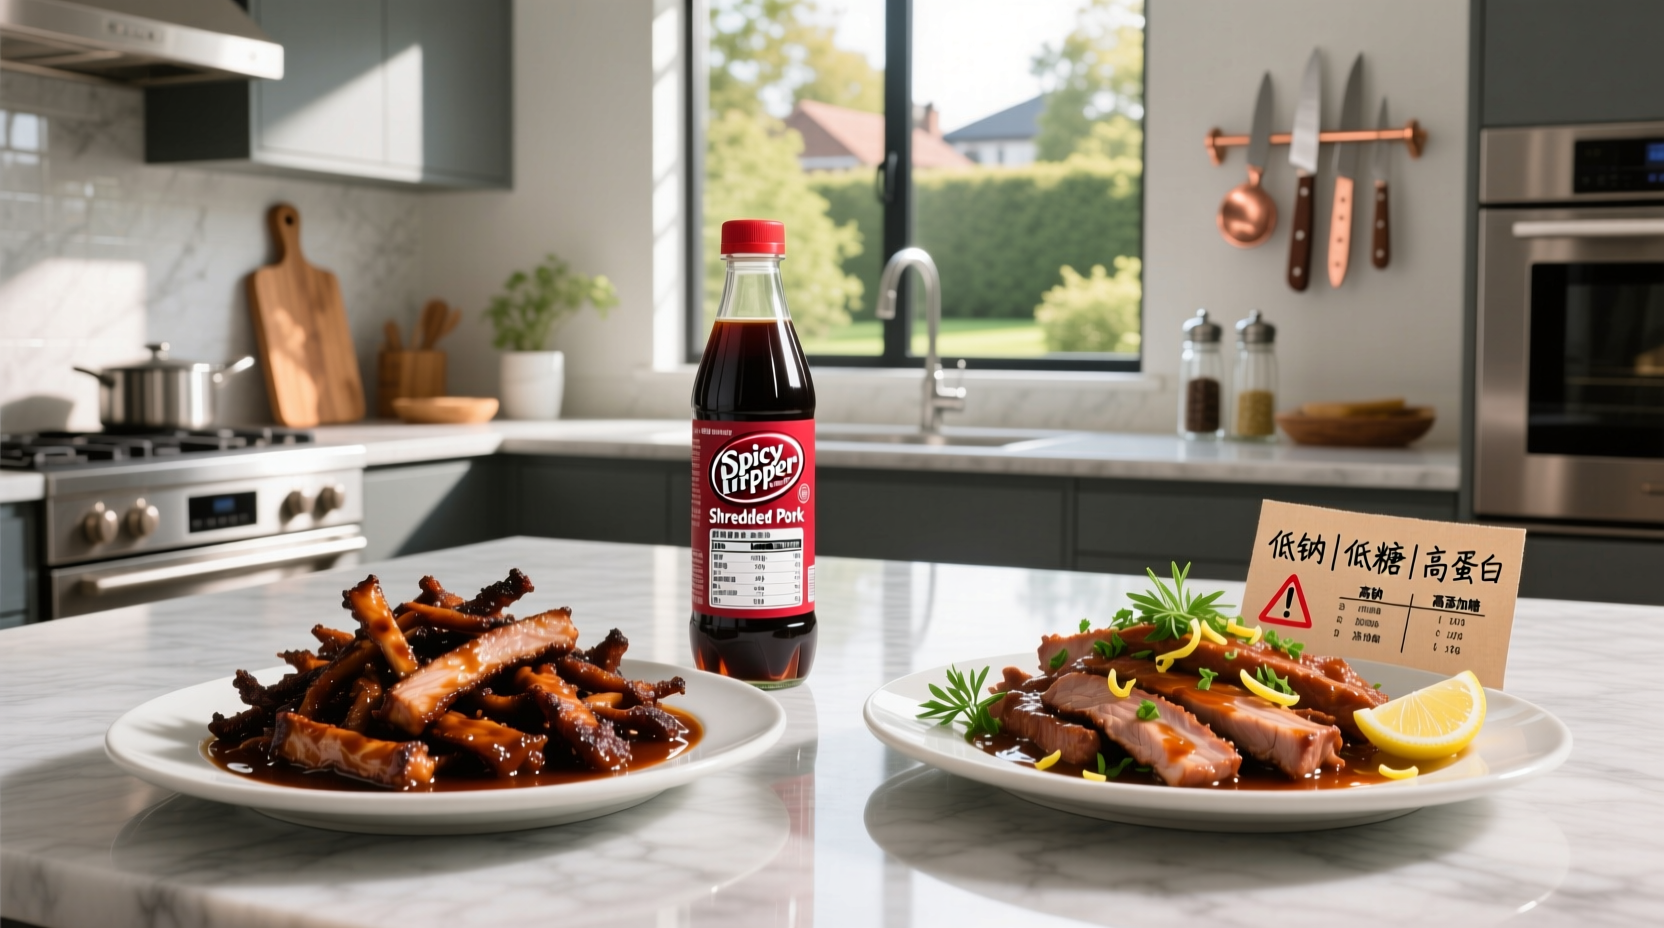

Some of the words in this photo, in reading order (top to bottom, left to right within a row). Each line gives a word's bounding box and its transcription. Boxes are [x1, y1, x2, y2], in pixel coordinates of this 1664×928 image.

[721, 443, 784, 479] Spicy
[709, 507, 773, 525] Shredded
[776, 506, 805, 524] Pork
[1268, 529, 1326, 565] 低钠
[1344, 539, 1407, 576] 低糖
[1423, 545, 1503, 585] 高蛋白
